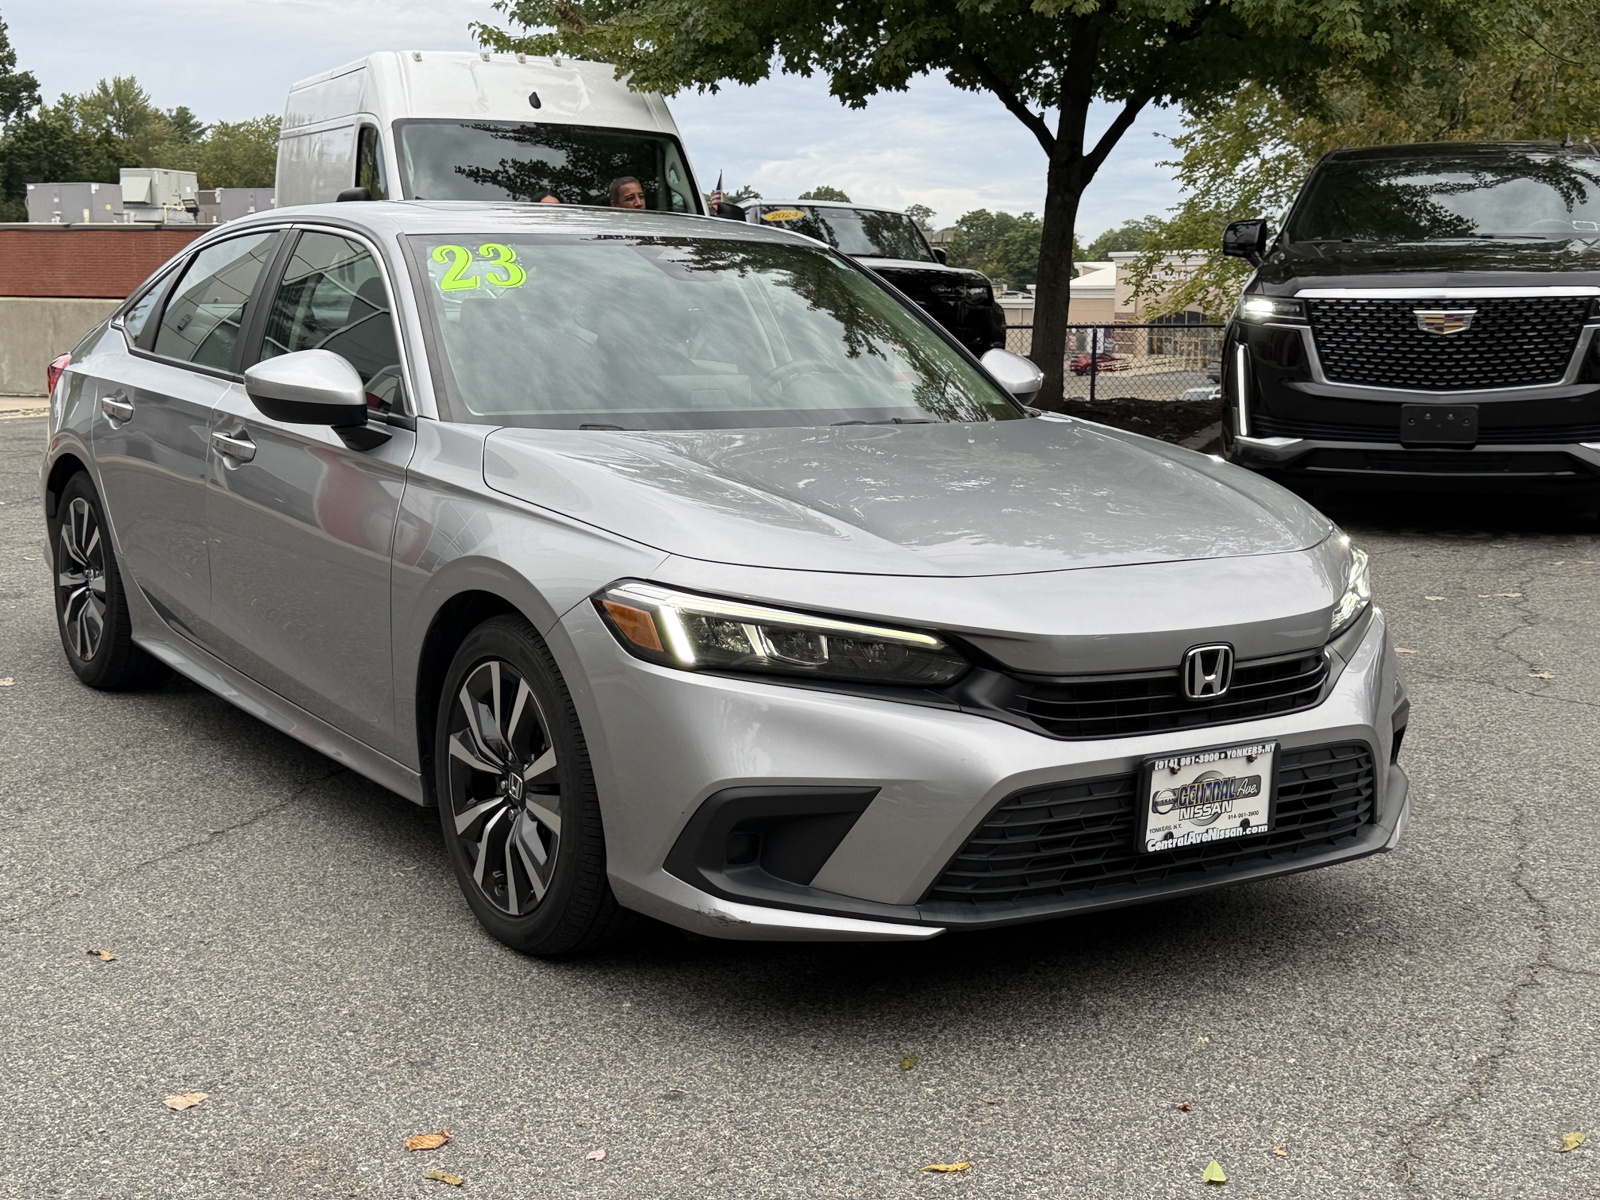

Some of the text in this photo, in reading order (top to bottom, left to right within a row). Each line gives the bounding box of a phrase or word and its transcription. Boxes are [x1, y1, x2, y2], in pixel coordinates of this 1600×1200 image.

[771, 211, 799, 220] 2024
[431, 243, 527, 292] 23
[1177, 776, 1236, 808] CENTRAL
[1178, 800, 1233, 821] NISSAN
[1146, 825, 1268, 852] CentralAveNissan.com
